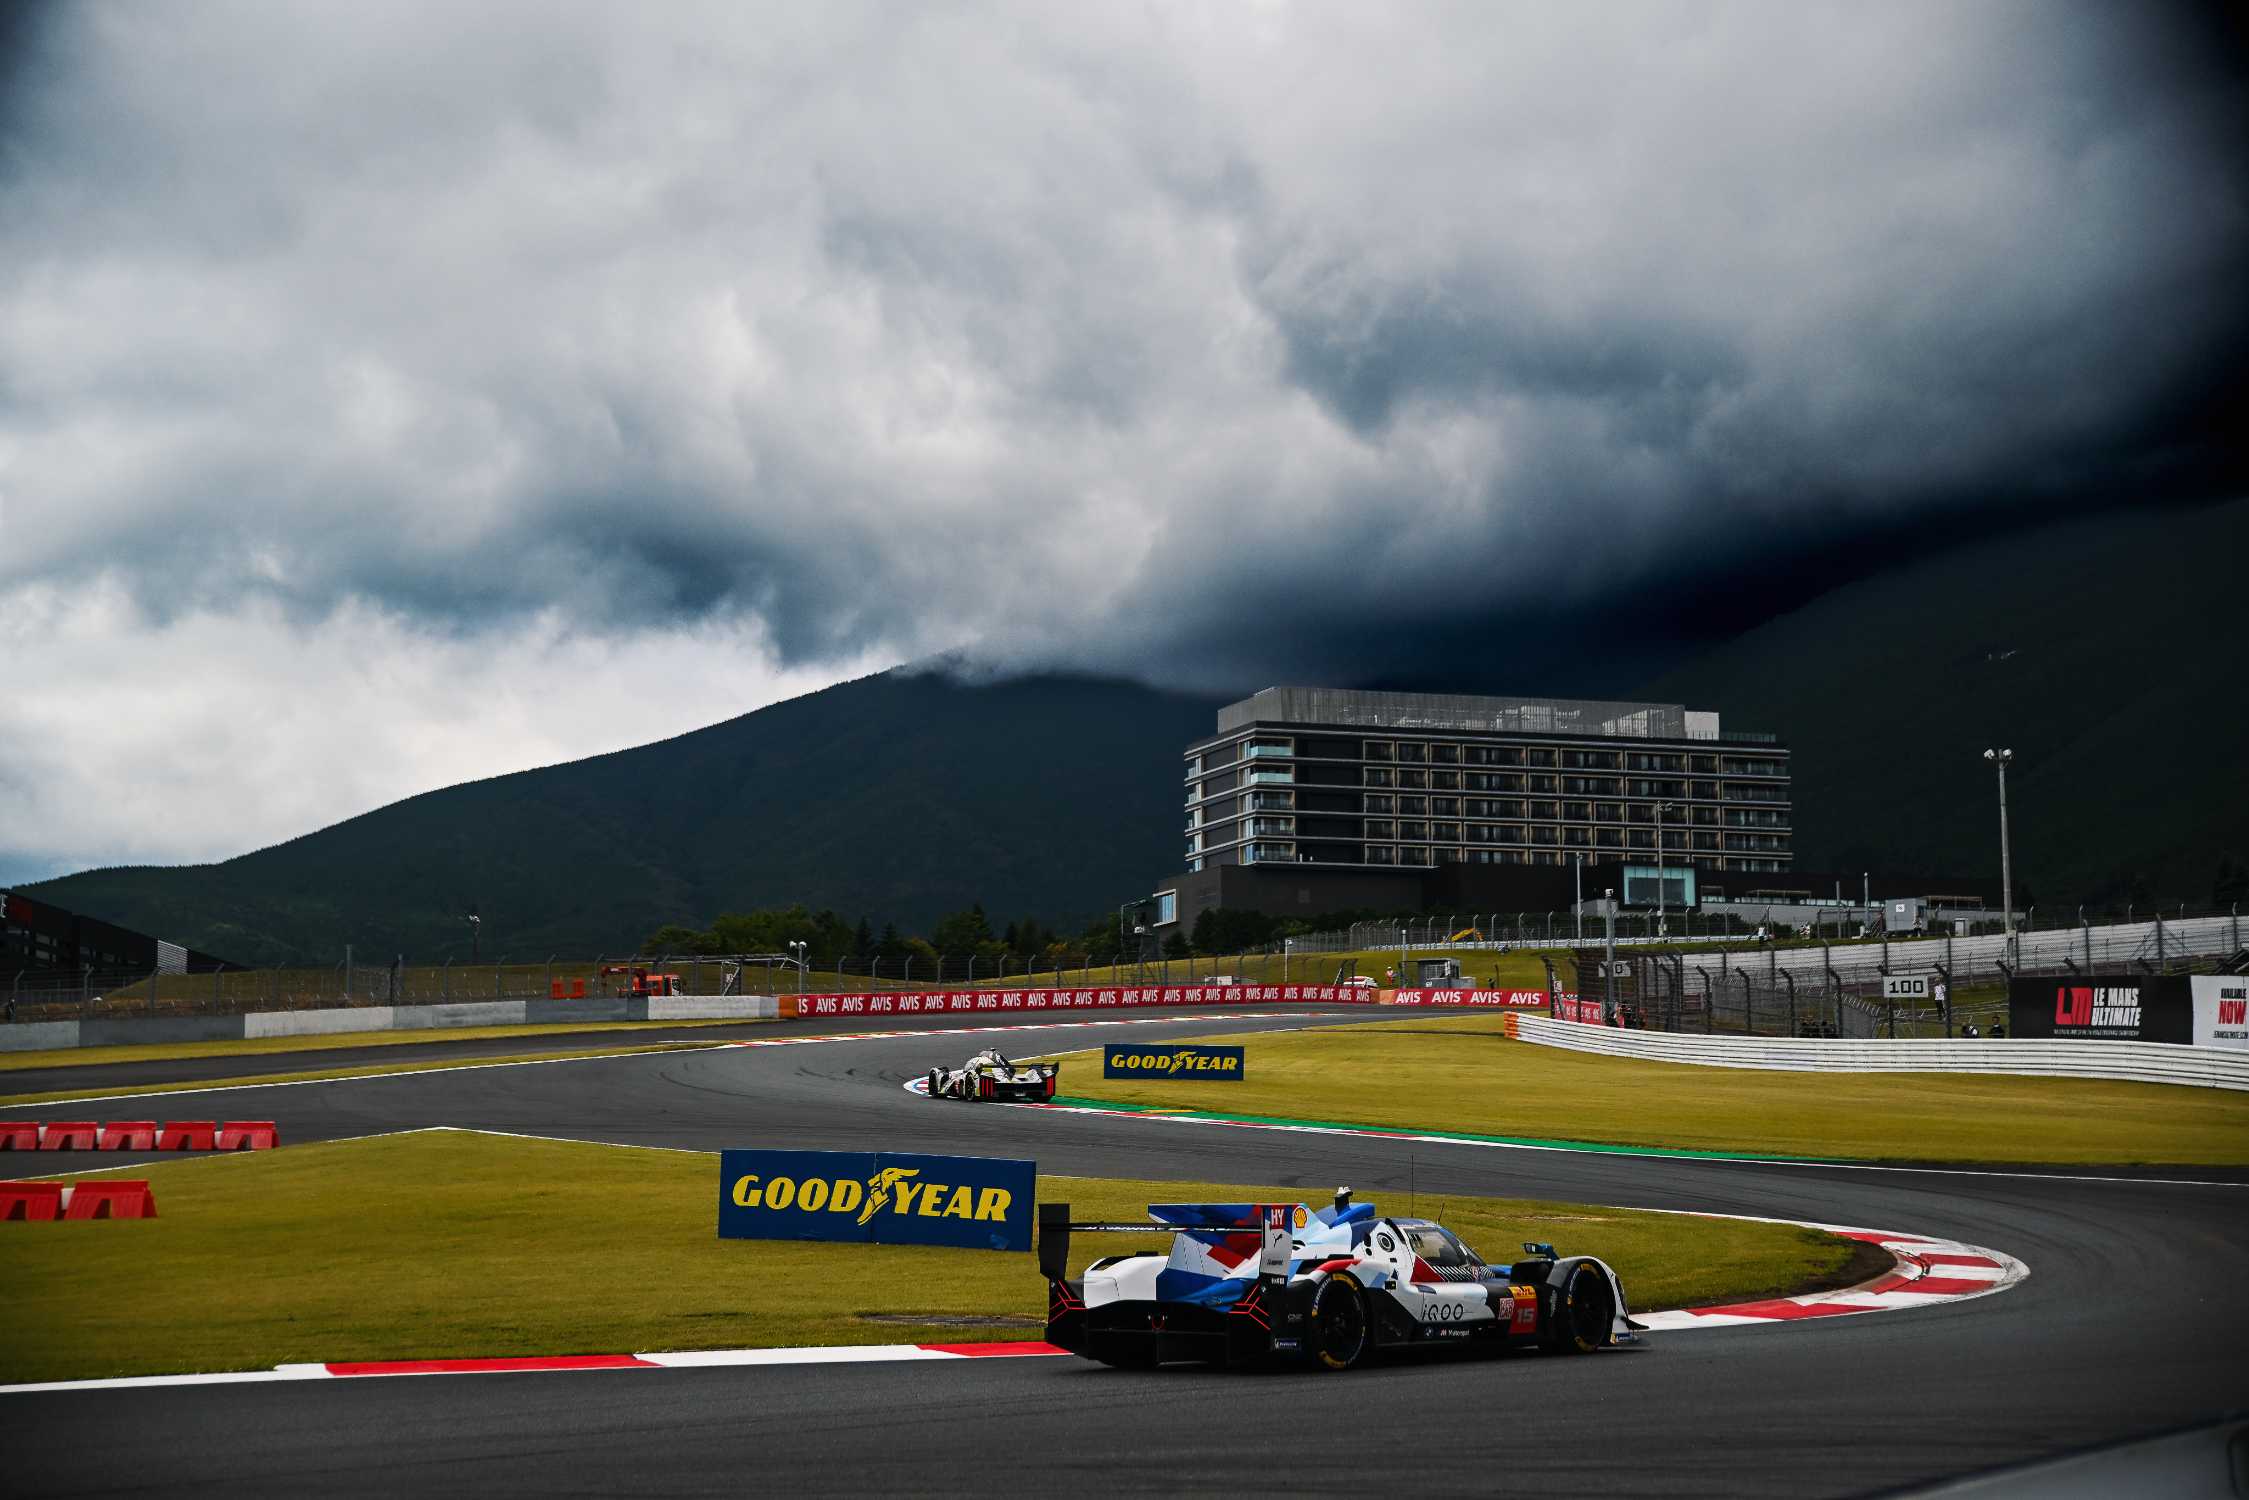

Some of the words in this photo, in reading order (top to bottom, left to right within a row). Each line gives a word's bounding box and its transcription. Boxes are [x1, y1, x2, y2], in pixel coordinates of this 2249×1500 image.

[1889, 980, 1924, 994] 100
[2221, 987, 2247, 999] AVAILABLE
[815, 997, 836, 1013] AVIS
[842, 996, 863, 1012] AVIS
[870, 996, 892, 1012] AVIS
[899, 995, 920, 1011] AVIS
[925, 995, 944, 1010] AVIS
[951, 994, 971, 1009] AVIS
[978, 993, 997, 1008] AVIS
[1002, 993, 1021, 1007] AVIS
[1027, 992, 1046, 1007] AVIS
[1052, 991, 1071, 1006] AVIS
[1075, 991, 1093, 1005] AVIS
[1098, 990, 1116, 1004] AVIS
[1122, 990, 1139, 1004] AVIS
[1142, 989, 1158, 1003] AVIS
[1163, 989, 1181, 1002] AVIS
[1185, 988, 1202, 1002] AVIS
[1245, 987, 1262, 1001] AVIS
[1395, 991, 1421, 1004] AVIS
[1431, 991, 1461, 1004] AVIS
[1470, 992, 1500, 1005] AVIS
[1509, 992, 1540, 1006] AVIS
[2093, 987, 2106, 1007] LE
[2108, 987, 2140, 1007] MANS
[2091, 1007, 2142, 1027] ULTIMATE
[2218, 1000, 2247, 1025] NOW
[1270, 1208, 1285, 1225] HY
[1421, 1303, 1464, 1321] iQOO
[1517, 1308, 1535, 1323] 15
